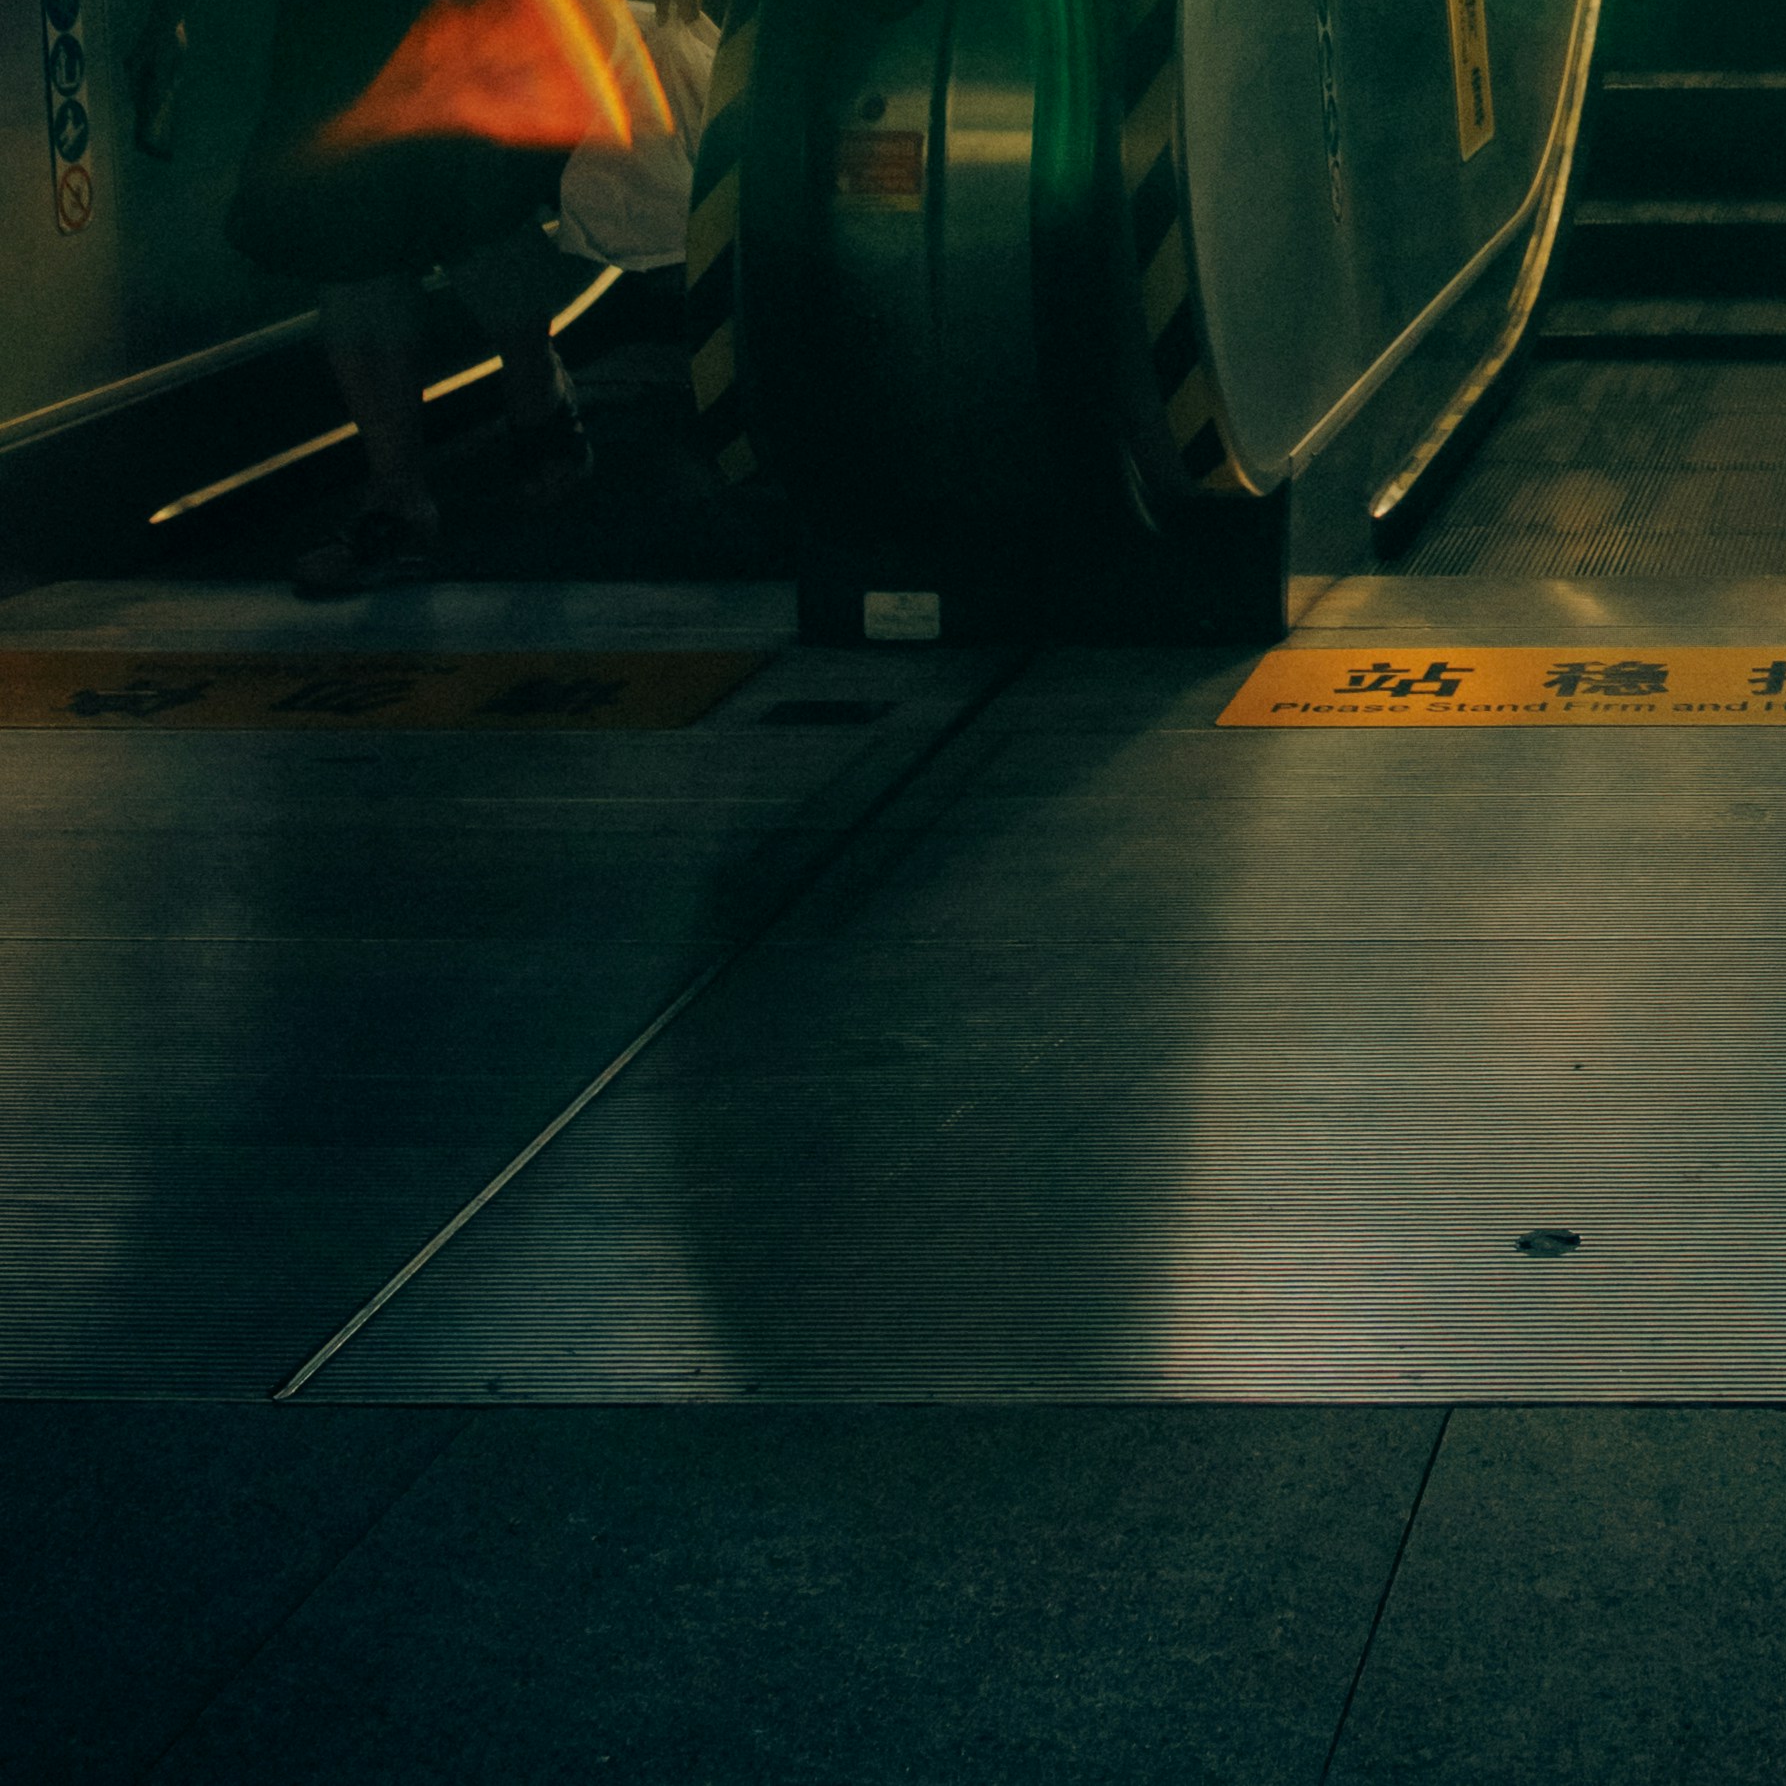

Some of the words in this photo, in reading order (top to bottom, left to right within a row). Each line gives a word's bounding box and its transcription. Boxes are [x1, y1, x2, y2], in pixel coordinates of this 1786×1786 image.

[1270, 701, 1411, 714] Please
[1426, 700, 1547, 714] Stand
[1563, 700, 1657, 713] Firm
[1671, 700, 1748, 713] and
